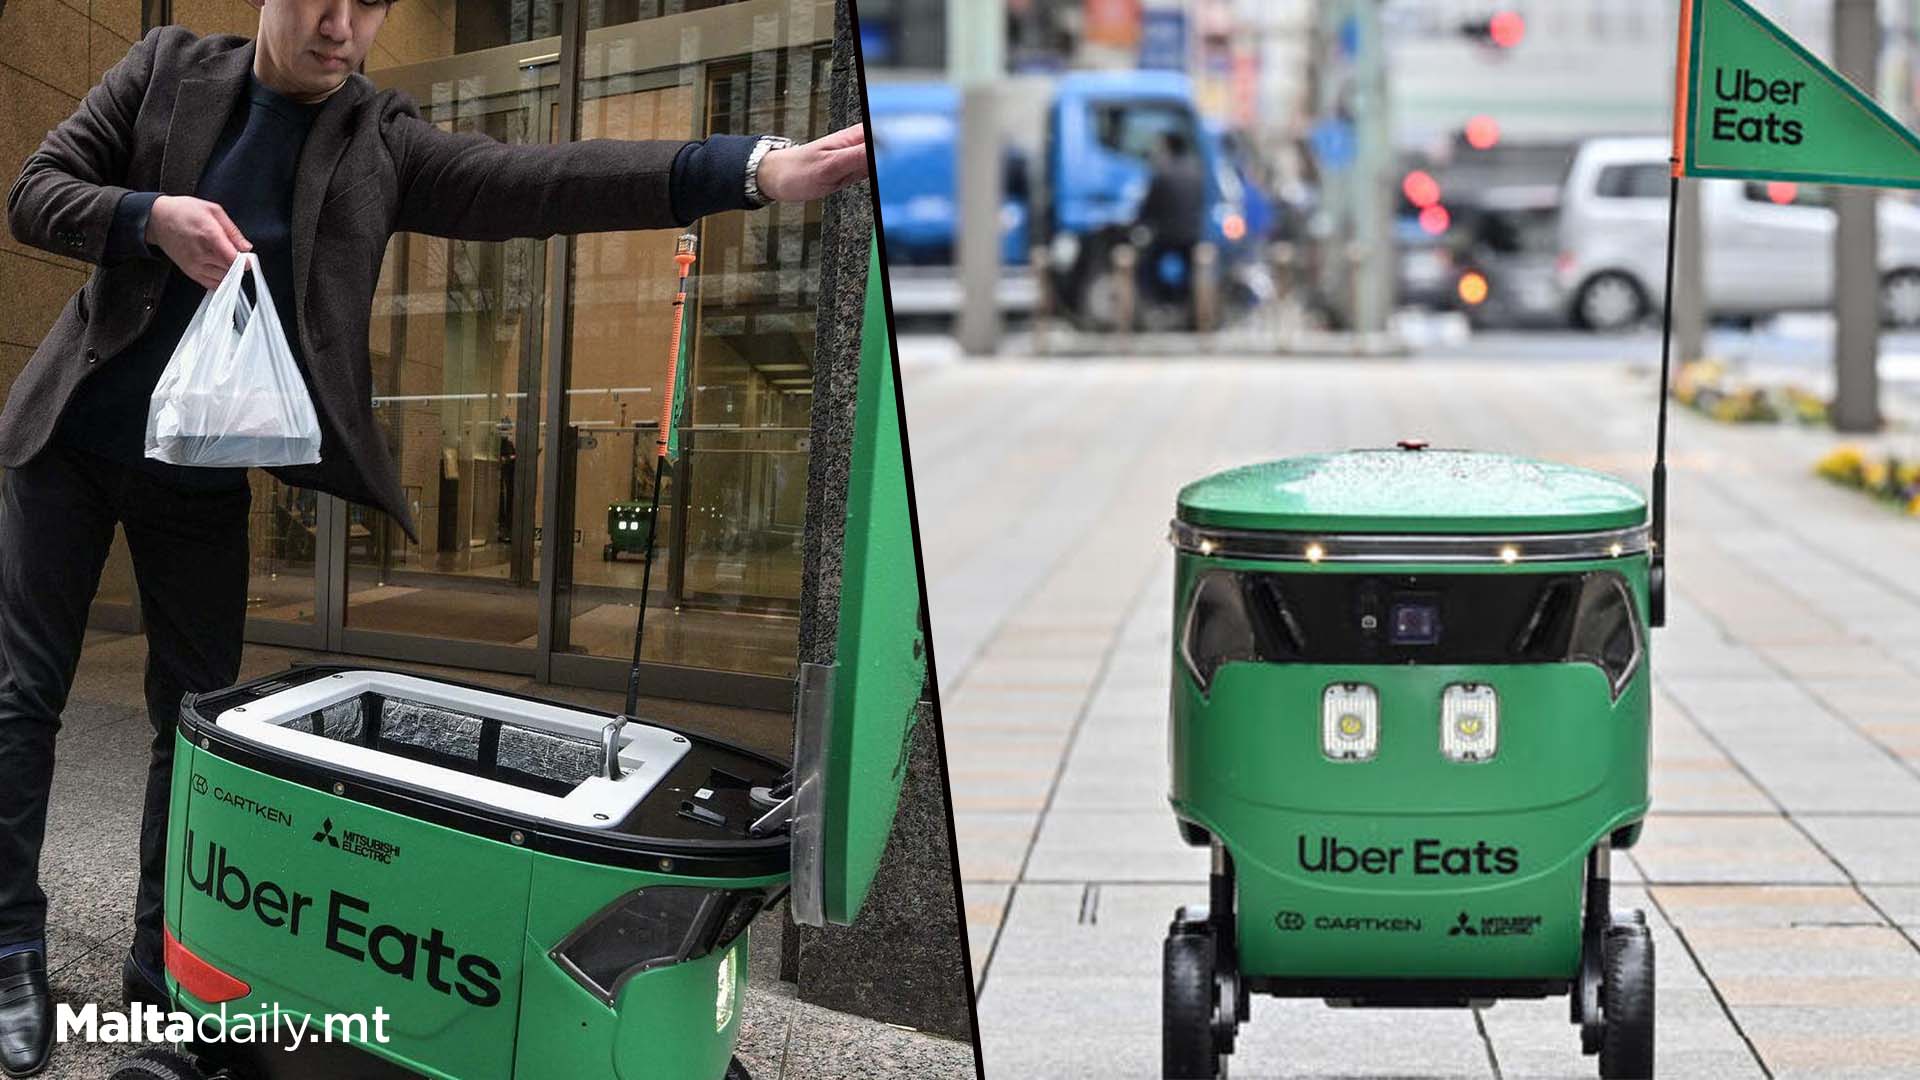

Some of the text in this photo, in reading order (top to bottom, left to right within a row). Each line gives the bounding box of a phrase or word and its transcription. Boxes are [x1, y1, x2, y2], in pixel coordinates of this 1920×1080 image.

[1715, 67, 1805, 105] Uber
[1713, 107, 1804, 145] Eats
[213, 787, 292, 827] CARTKEN
[342, 841, 392, 864] ELECTRIC
[343, 830, 400, 857] MITSUBISHI
[1298, 835, 1519, 875] Uber Eats
[186, 829, 502, 1008] Uber Eats
[1314, 917, 1422, 931] CARTKEN
